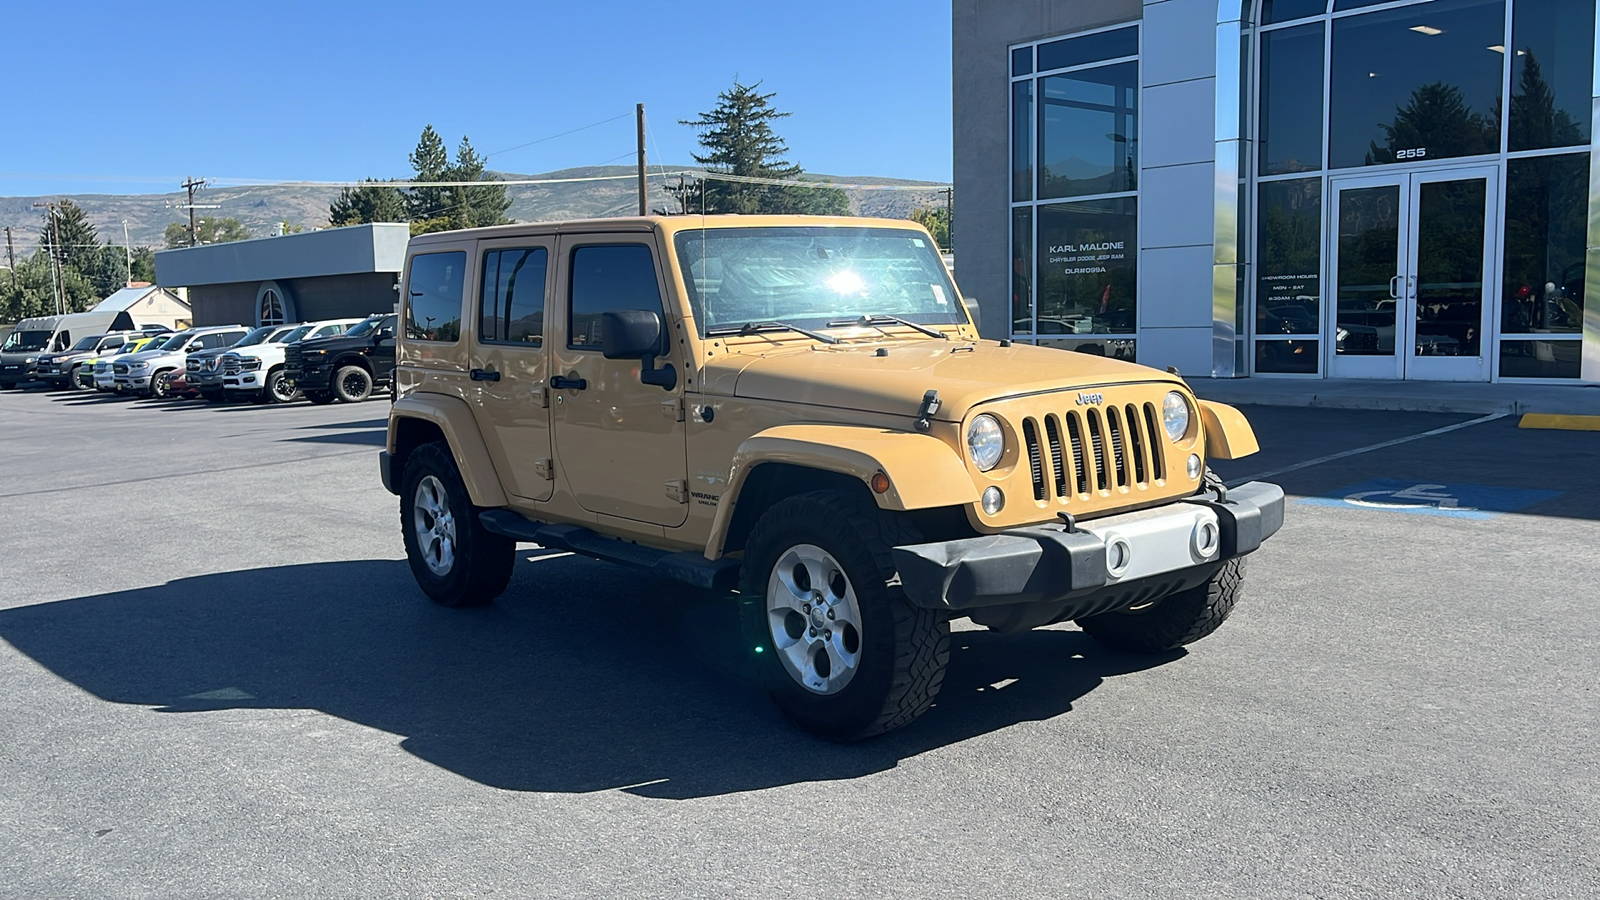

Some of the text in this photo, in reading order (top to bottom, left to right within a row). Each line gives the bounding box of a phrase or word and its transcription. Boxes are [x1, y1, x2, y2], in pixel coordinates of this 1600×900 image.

[1396, 147, 1426, 159] 255
[1049, 241, 1124, 253] KARL MALONE
[1075, 391, 1104, 407] Jeep
[691, 491, 719, 501] WRANG
